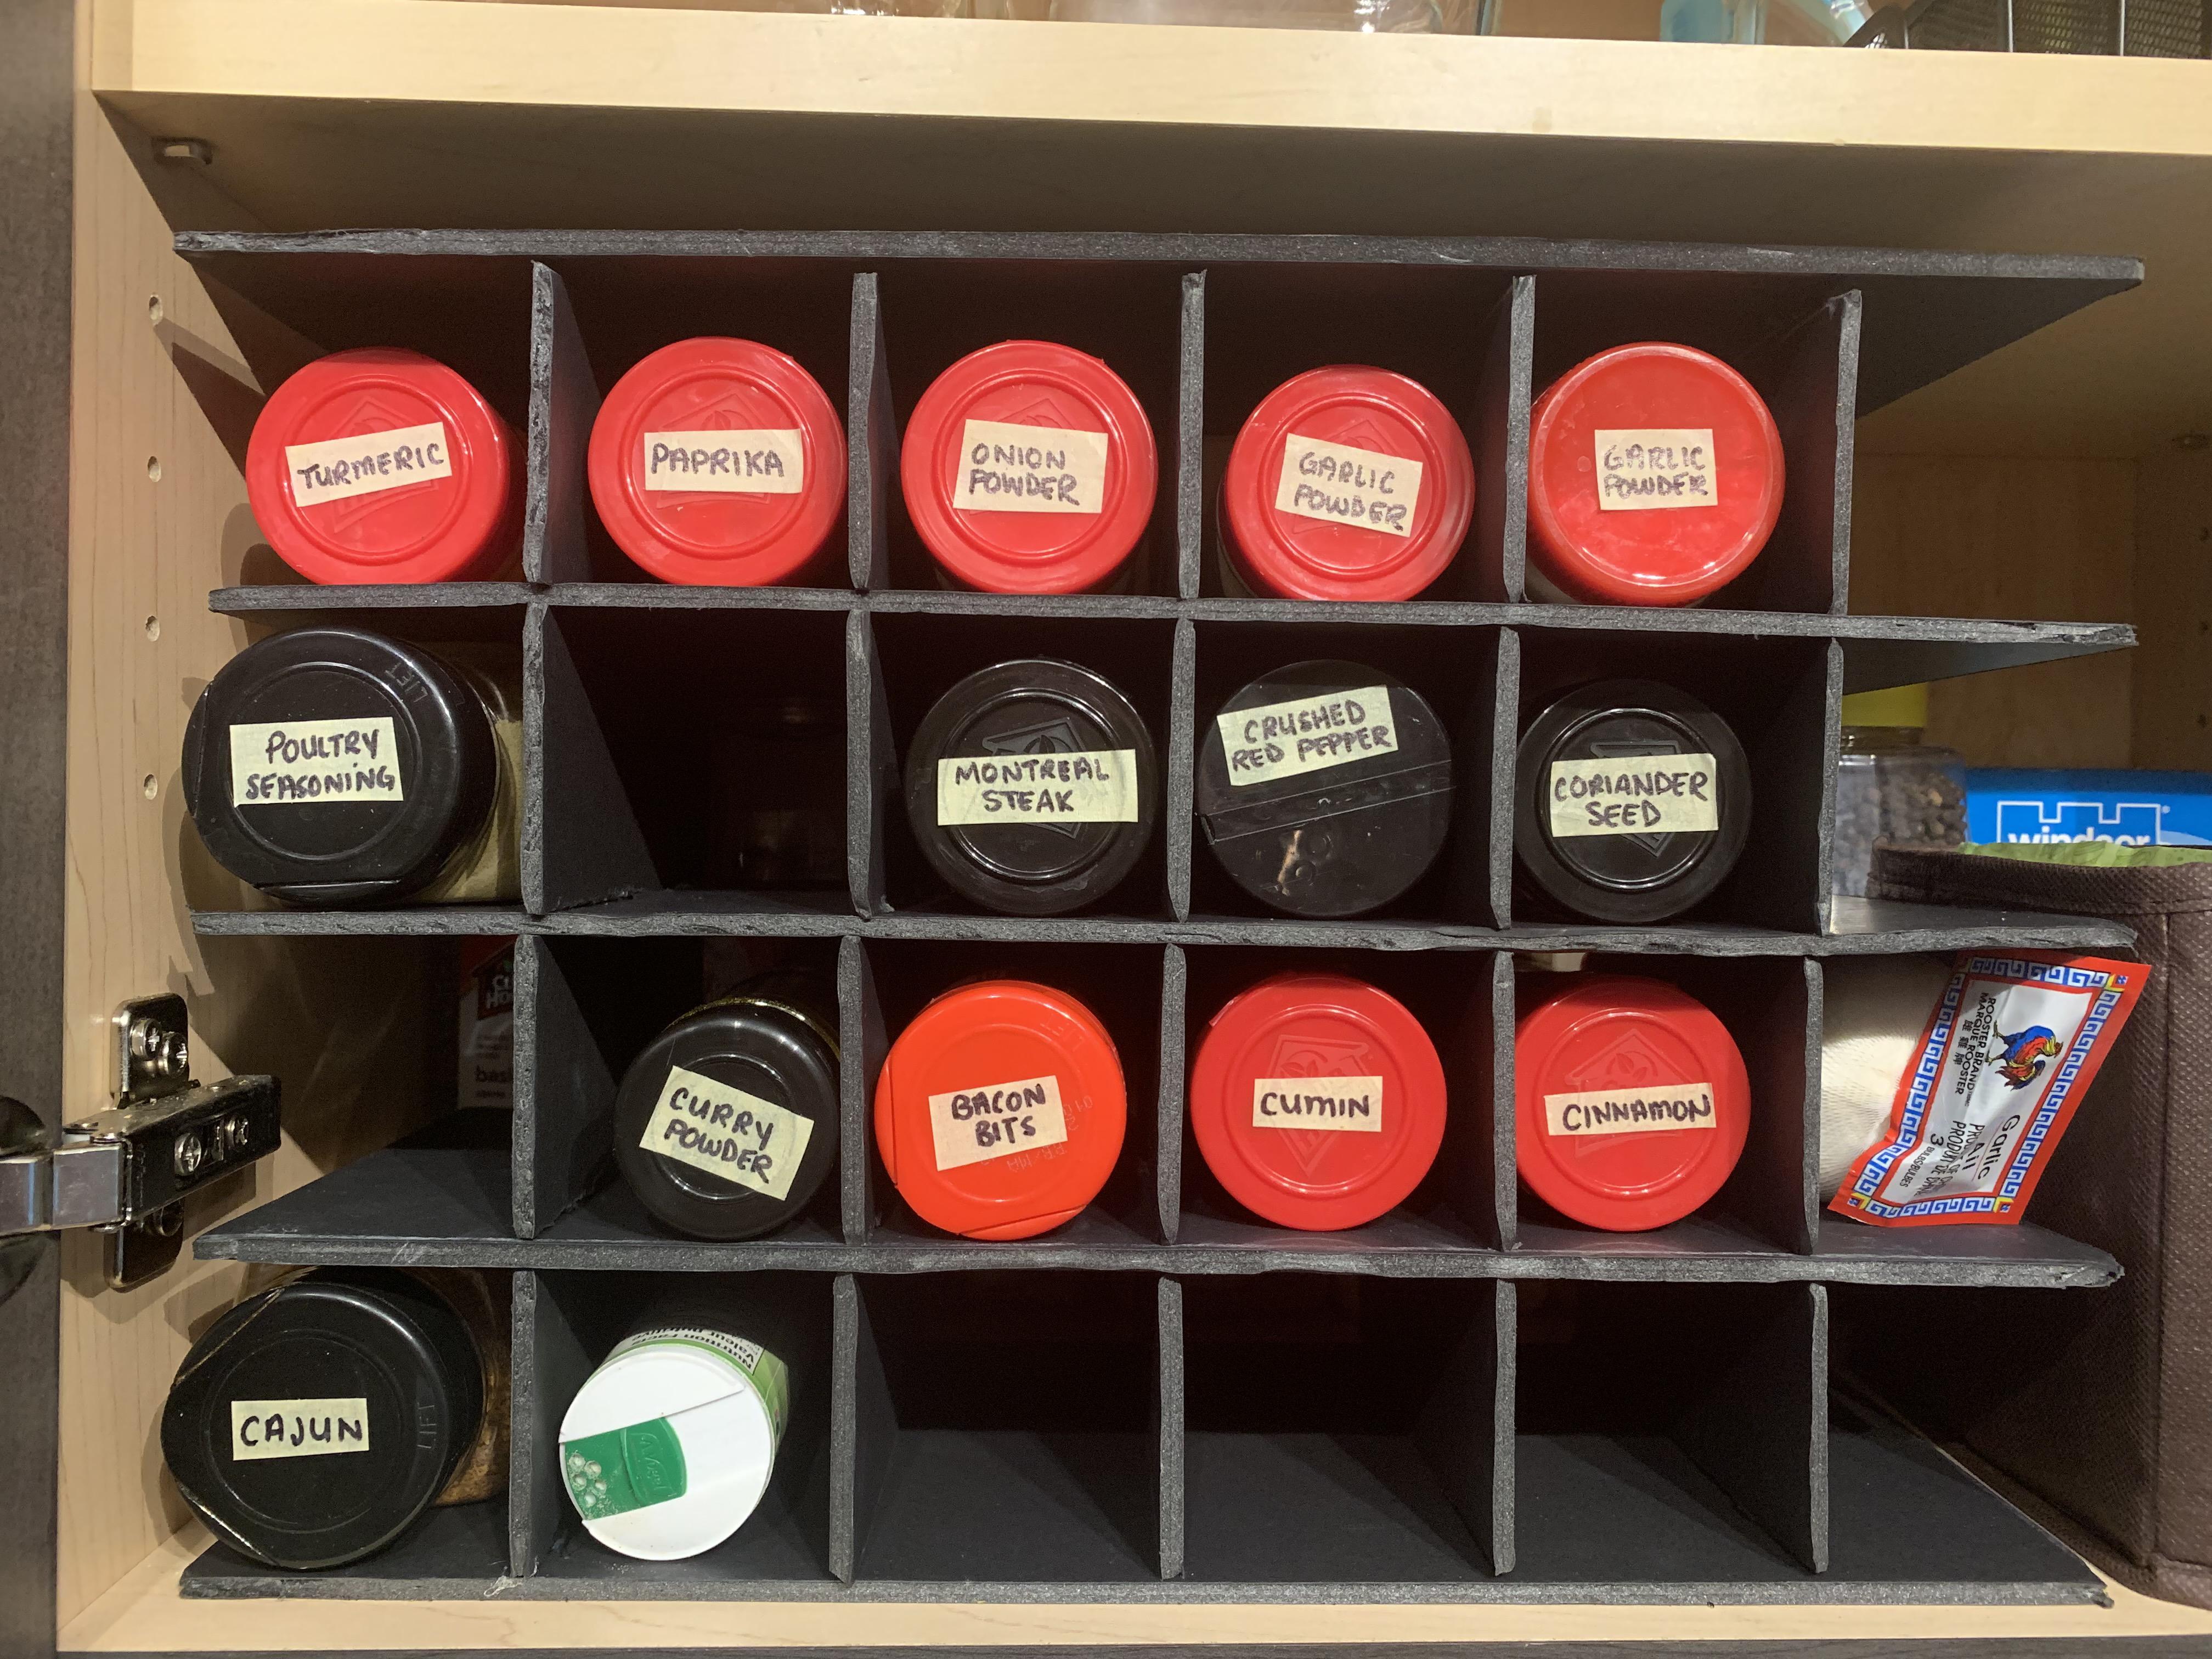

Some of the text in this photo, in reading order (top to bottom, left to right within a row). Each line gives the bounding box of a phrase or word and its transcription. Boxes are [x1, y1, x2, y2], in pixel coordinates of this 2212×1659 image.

[297, 443, 445, 490] TURMERIC
[652, 443, 785, 477] PAPRIKA
[972, 443, 1065, 470] ONION
[1299, 451, 1395, 494] GARLIC
[1604, 444, 1705, 471] GARLIC
[969, 470, 1080, 506] POWDER
[1604, 472, 1708, 499] POWDER
[1294, 484, 1408, 532] POWDER
[1244, 699, 1365, 743] CRUSHED
[266, 729, 380, 764] POULTRY
[1231, 725, 1392, 772] RED PEPPER
[245, 762, 395, 800] SEASONING
[955, 757, 1109, 785] MONTREAL
[1554, 771, 1708, 802] CORIANDER
[982, 788, 1074, 813] STEAK
[1585, 799, 1661, 828] SEED
[1977, 996, 1996, 1048] ROOSTER
[1955, 992, 1989, 1095] MARQUE ROOSTER
[1967, 1051, 1984, 1091] BRAND
[669, 1087, 774, 1151] CURRY
[951, 1084, 1046, 1120] BACON
[1260, 1091, 1370, 1118] CUMIN
[1562, 1094, 1711, 1131] CINNAMON
[975, 1115, 1036, 1147] BITS
[1930, 1133, 1944, 1147] 3
[1977, 1114, 2021, 1180] Garlic
[664, 1119, 773, 1184] POWDER
[684, 1334, 752, 1369] Nutrition
[709, 1331, 754, 1364] Valeur
[240, 1413, 363, 1447] CAJUN
